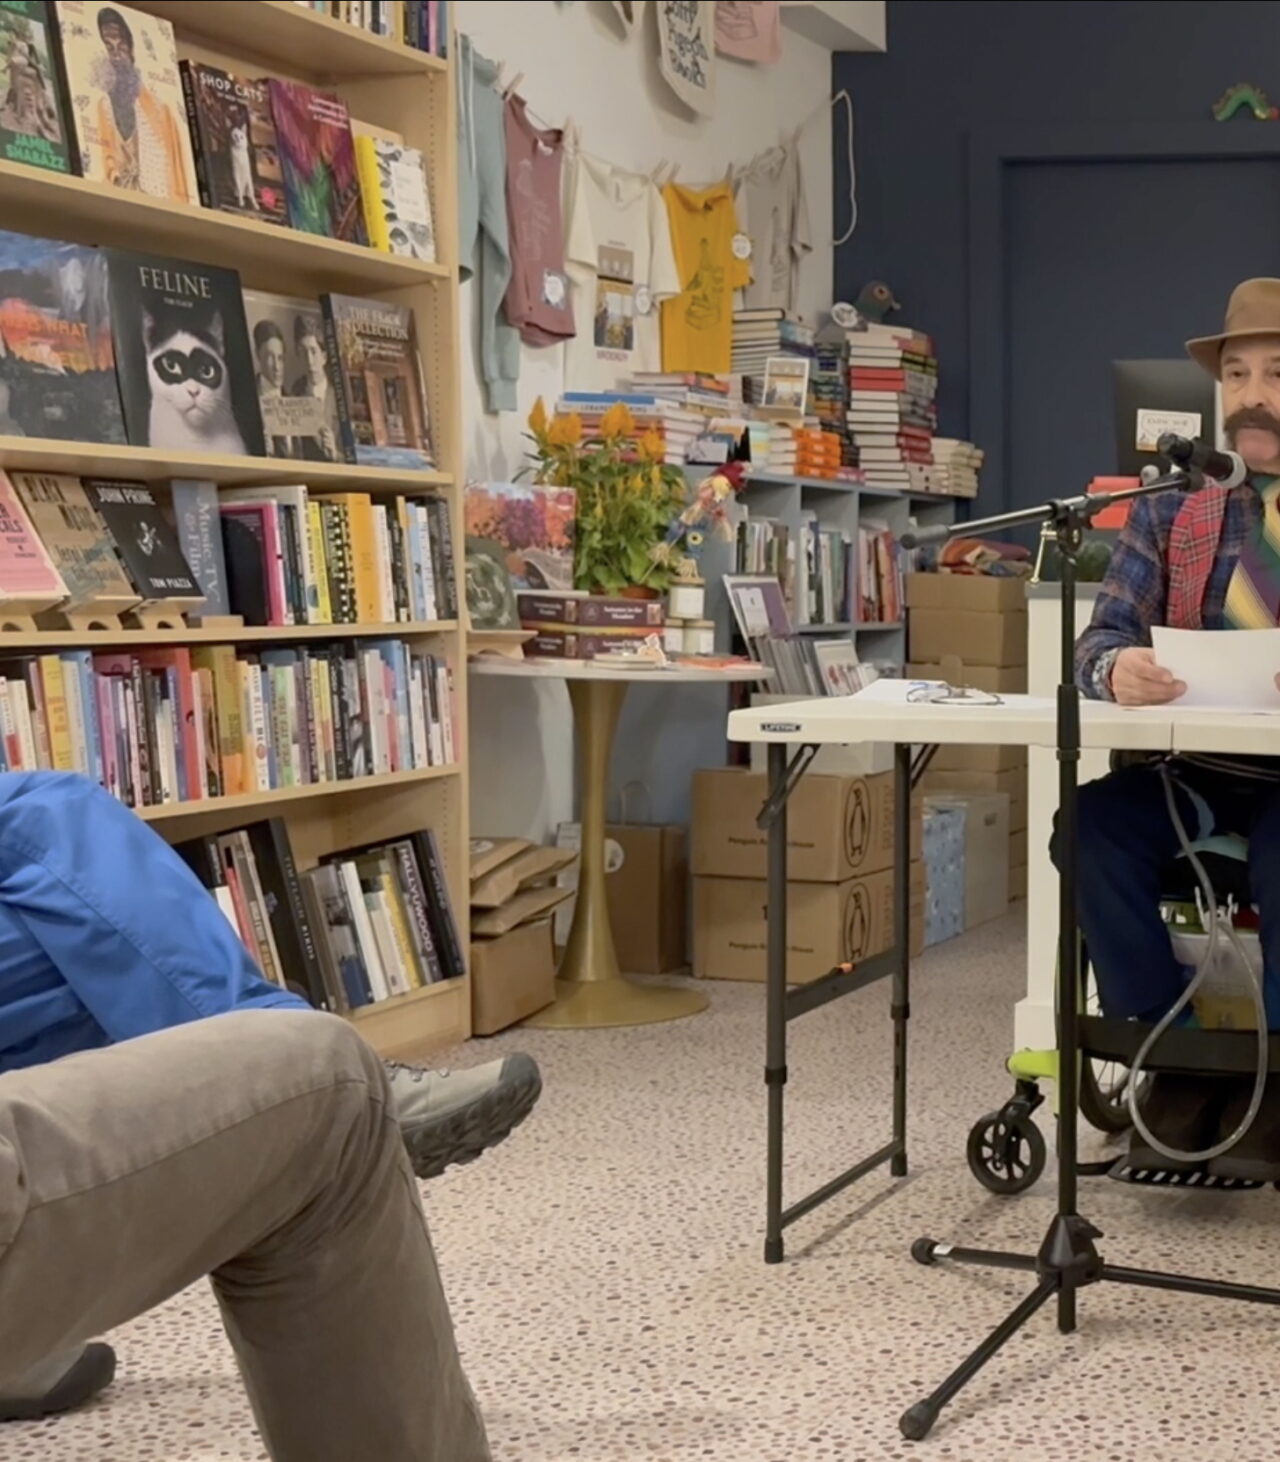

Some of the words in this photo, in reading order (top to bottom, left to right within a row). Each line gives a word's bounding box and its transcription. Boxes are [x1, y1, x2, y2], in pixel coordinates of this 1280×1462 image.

[200, 72, 232, 91] SHOP
[234, 84, 263, 102] CATS
[138, 266, 212, 298] FELINE
[350, 306, 370, 320] THE
[96, 486, 126, 503] JOHN
[121, 487, 156, 505] PRINE
[149, 577, 168, 589] TOM
[166, 577, 193, 589] PIAZZA
[728, 836, 757, 846] Penguin
[399, 847, 433, 952] HALLYUWOOD
[301, 924, 315, 961] BIRDS
[728, 941, 758, 950] Penguin
